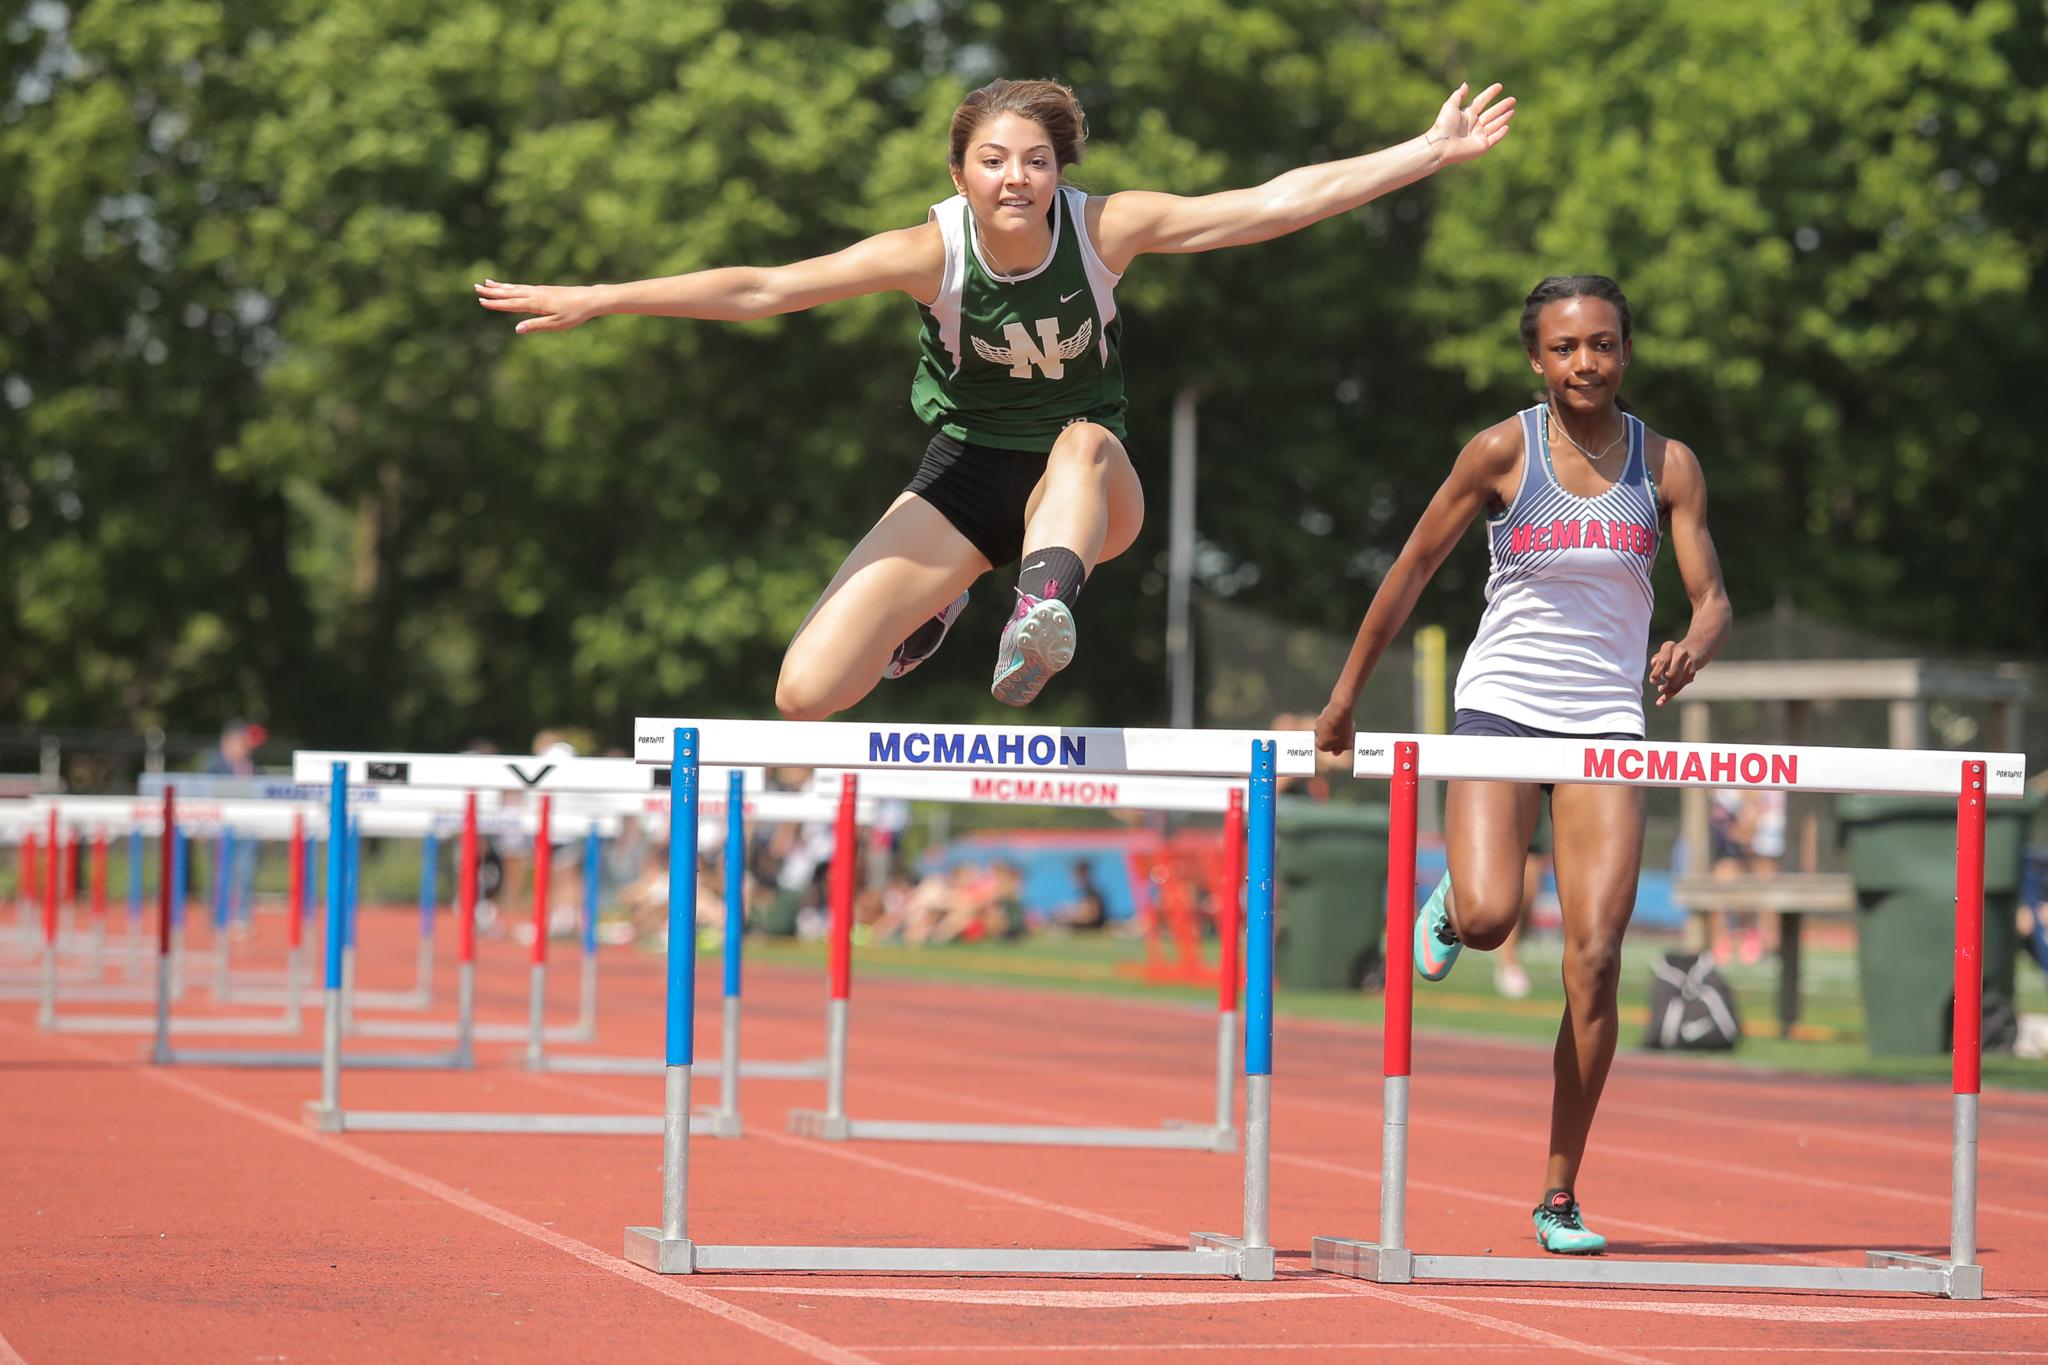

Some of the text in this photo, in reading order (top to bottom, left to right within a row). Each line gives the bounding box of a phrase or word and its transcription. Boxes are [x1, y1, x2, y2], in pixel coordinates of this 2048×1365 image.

[1003, 317, 1064, 380] N
[869, 732, 1086, 766] MCMAHON
[1584, 748, 1798, 784] MCMAHON
[972, 777, 1118, 804] MCMAHON
